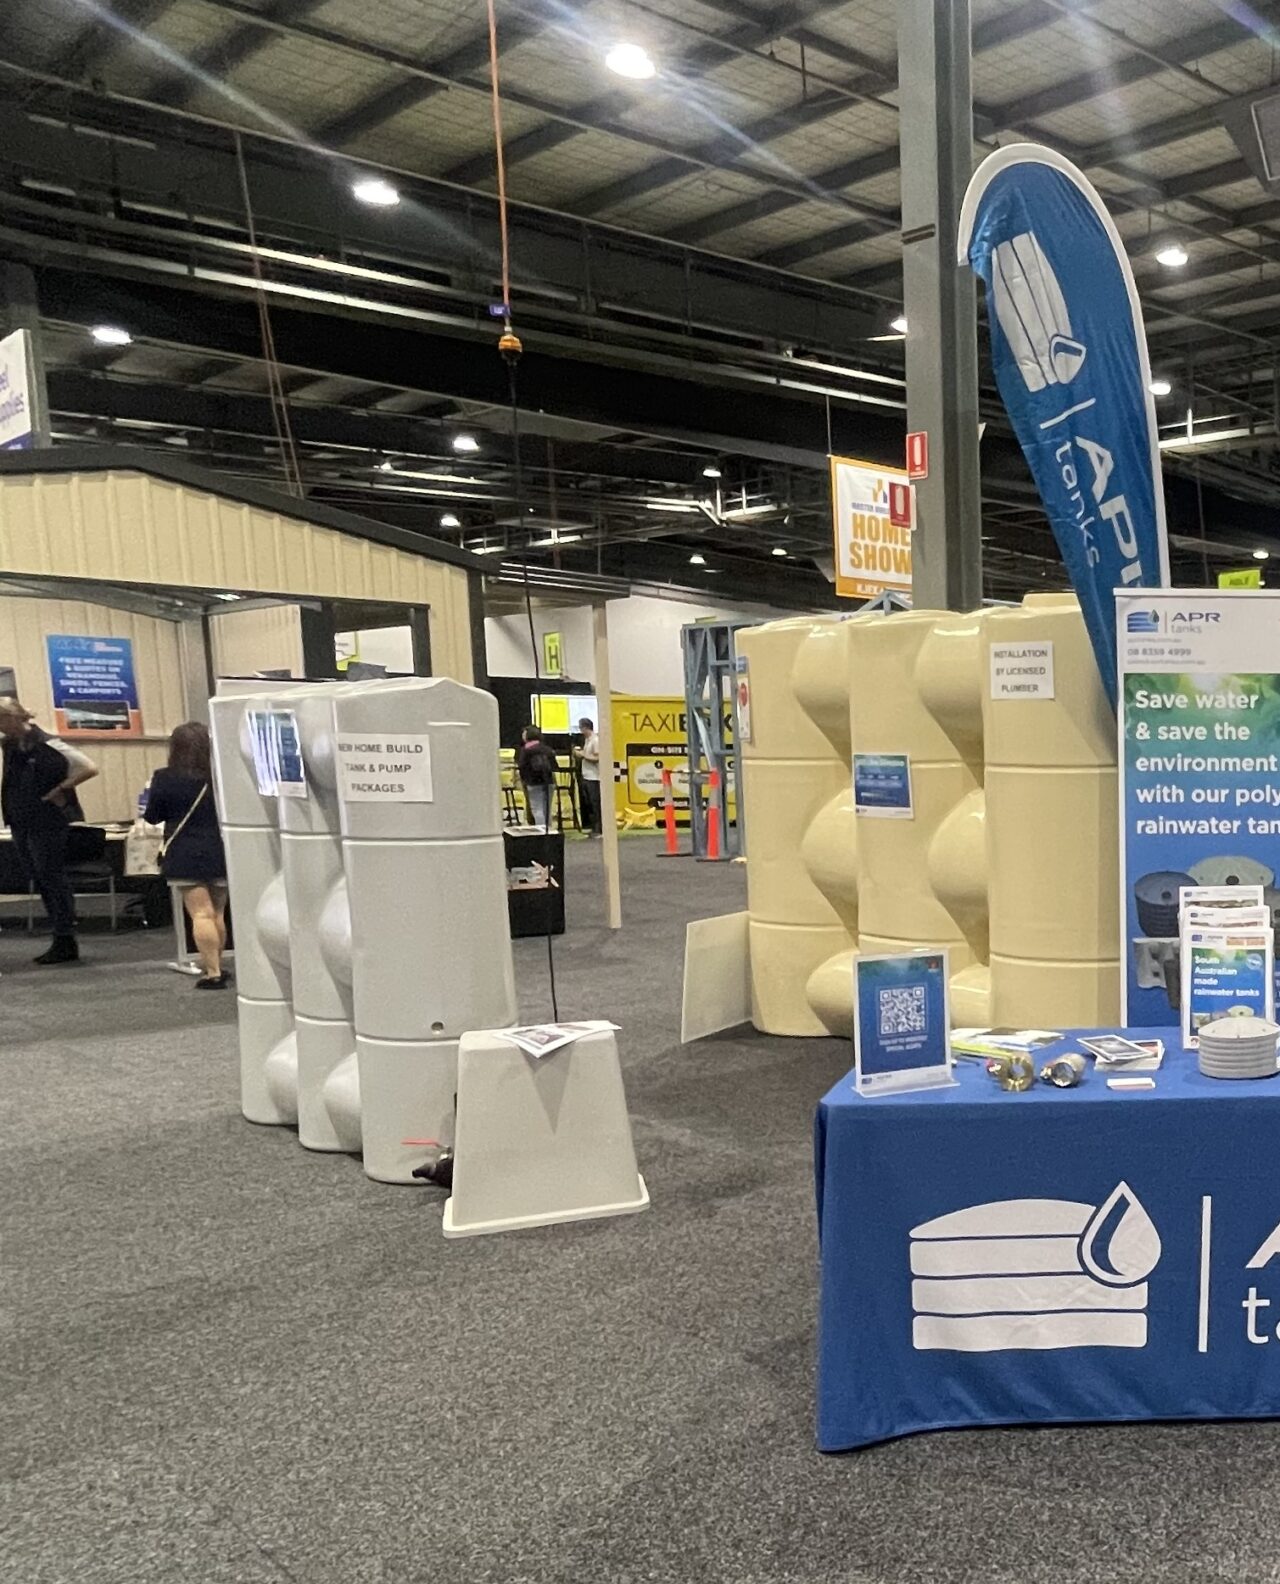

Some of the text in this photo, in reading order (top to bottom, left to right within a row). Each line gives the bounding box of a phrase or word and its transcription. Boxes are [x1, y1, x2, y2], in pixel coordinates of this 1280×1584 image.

[1054, 441, 1101, 569] tanks
[852, 512, 911, 546] HOME
[849, 541, 912, 575] SHOW
[1171, 611, 1221, 623] APR
[1170, 623, 1203, 634] tanks
[548, 644, 560, 671] H
[993, 649, 1048, 659] INSTALLATION
[1135, 690, 1259, 709] Save water
[1135, 722, 1251, 741] & save the
[354, 743, 382, 753] HOME
[386, 744, 424, 754] BUILD
[345, 763, 412, 773] TANK & PUMP
[1135, 753, 1278, 773] environment
[351, 784, 406, 793] PACKAGES
[1136, 785, 1185, 804] with
[1191, 788, 1230, 804] our
[1136, 814, 1240, 835] rainwater
[1194, 955, 1220, 965] South
[1194, 966, 1238, 976] Australian
[1193, 977, 1219, 986] made
[1193, 987, 1260, 997] rainwater tanks
